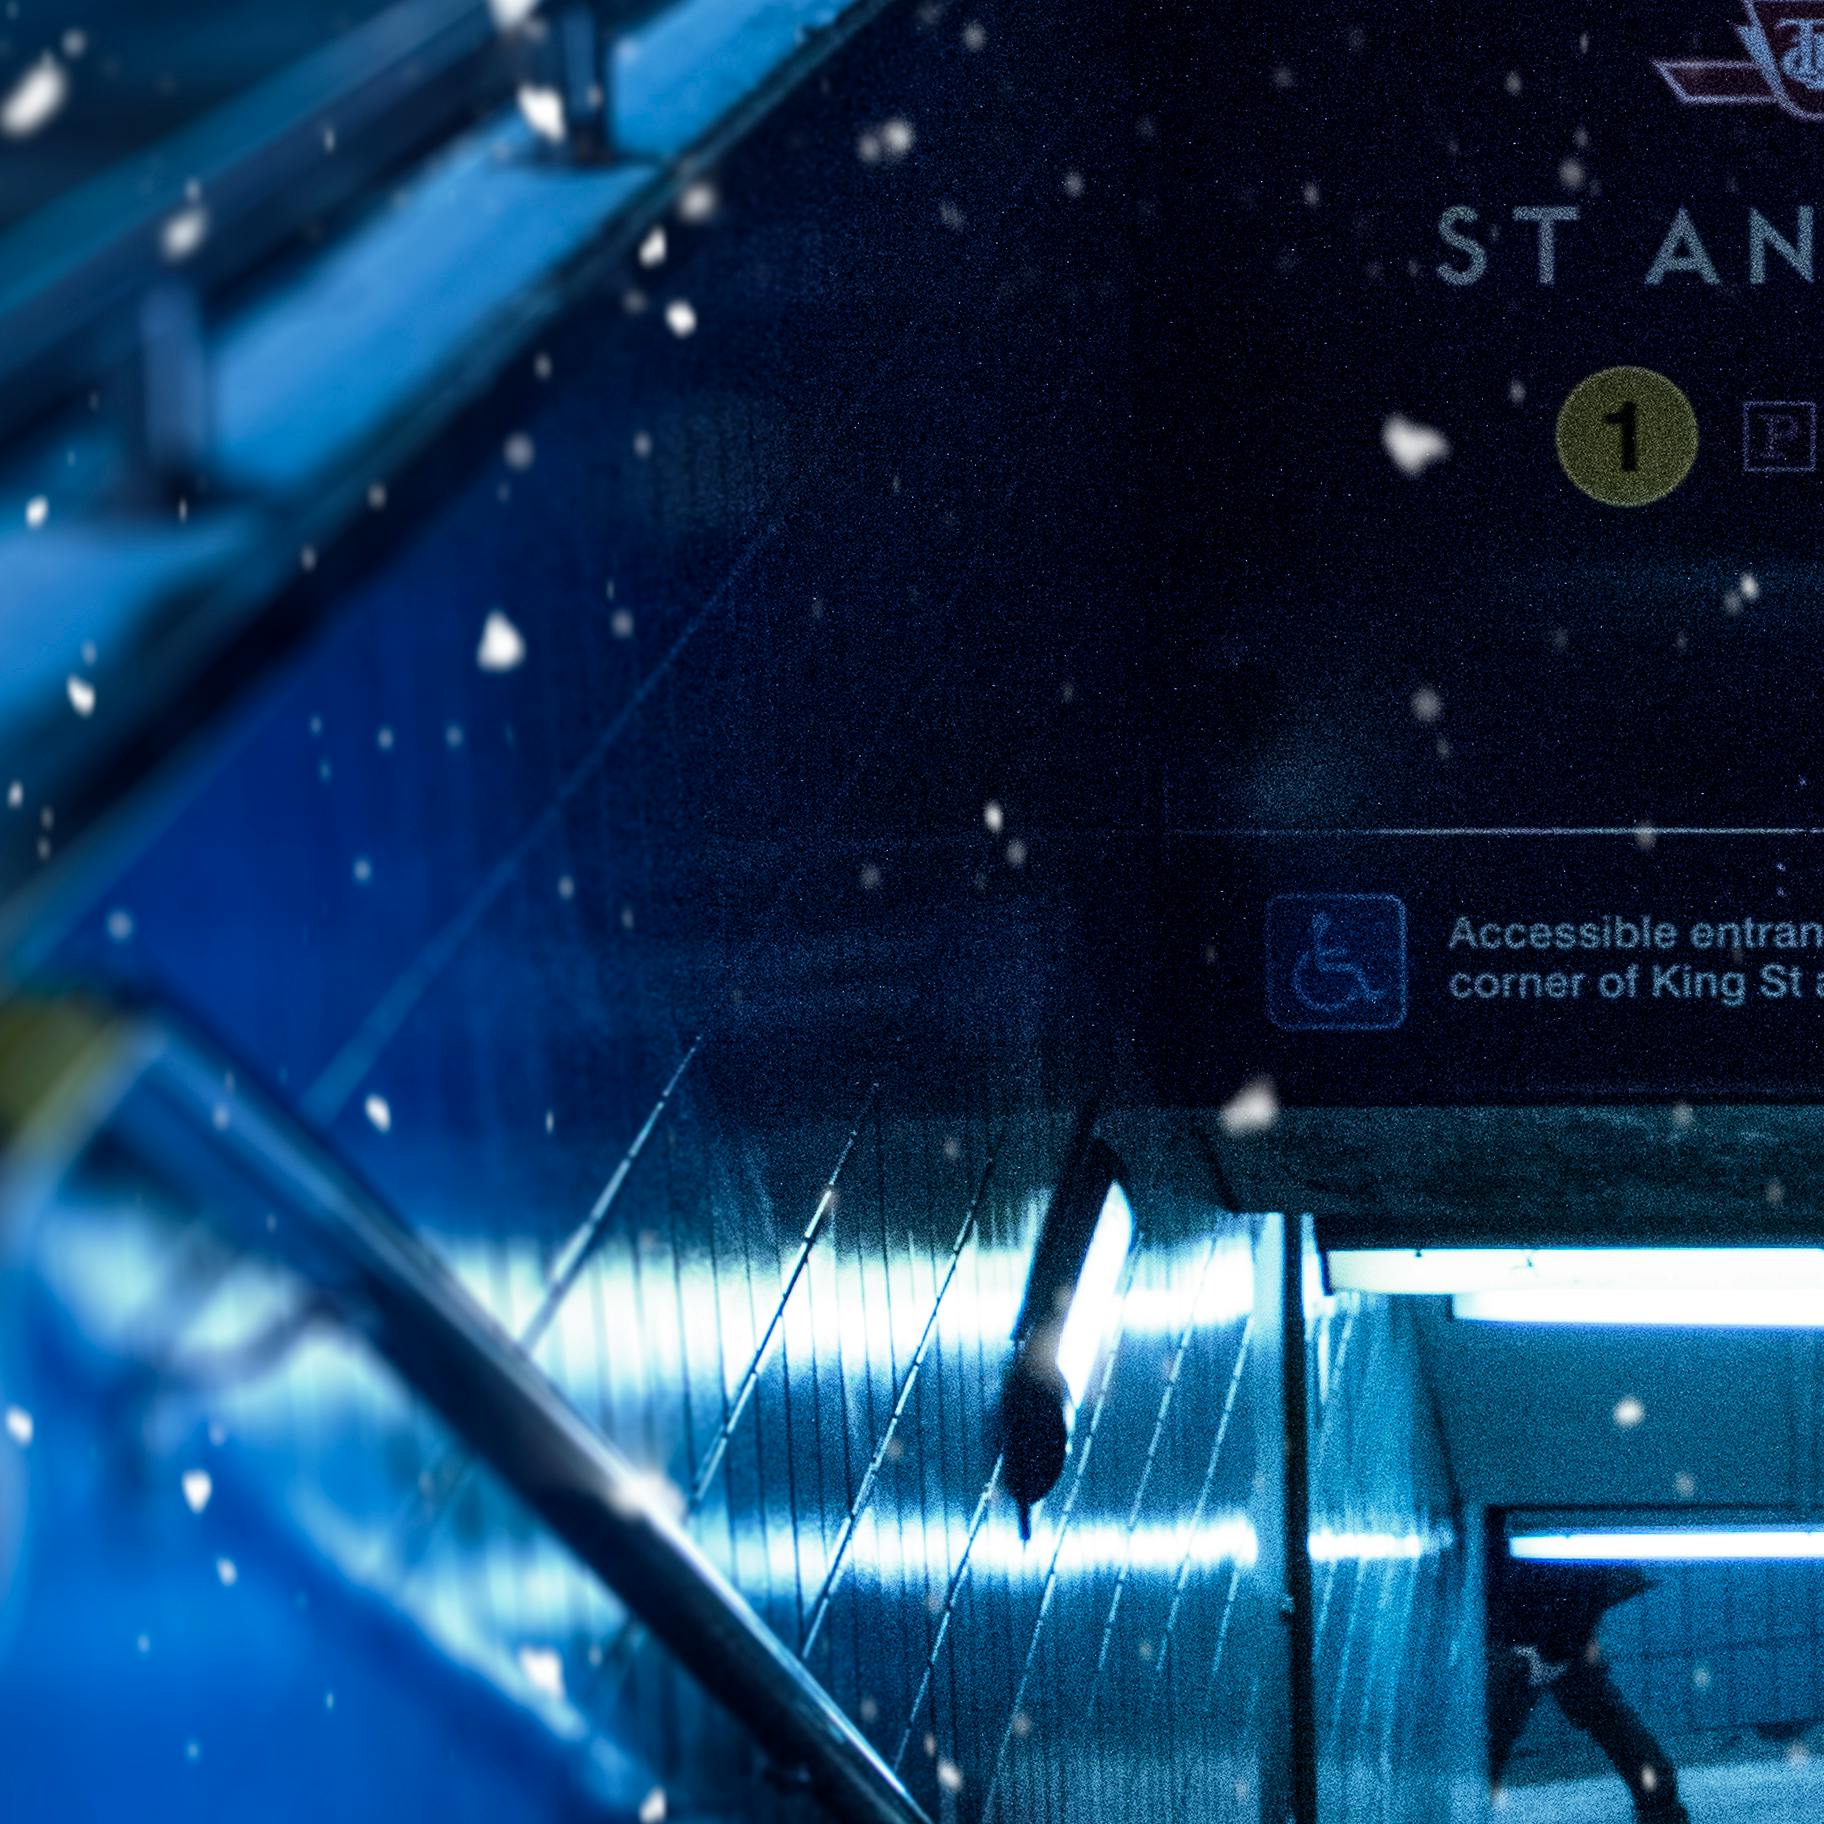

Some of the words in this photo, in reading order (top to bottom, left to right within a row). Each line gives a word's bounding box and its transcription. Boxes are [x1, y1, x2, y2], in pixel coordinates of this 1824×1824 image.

[1436, 205, 1582, 286] ST
[1604, 401, 1638, 472] 1
[1449, 914, 1678, 949] Accessible
[1450, 972, 1586, 999] corner
[1600, 964, 1640, 999] of
[1651, 964, 1746, 1006] King
[1760, 964, 1803, 999] St
